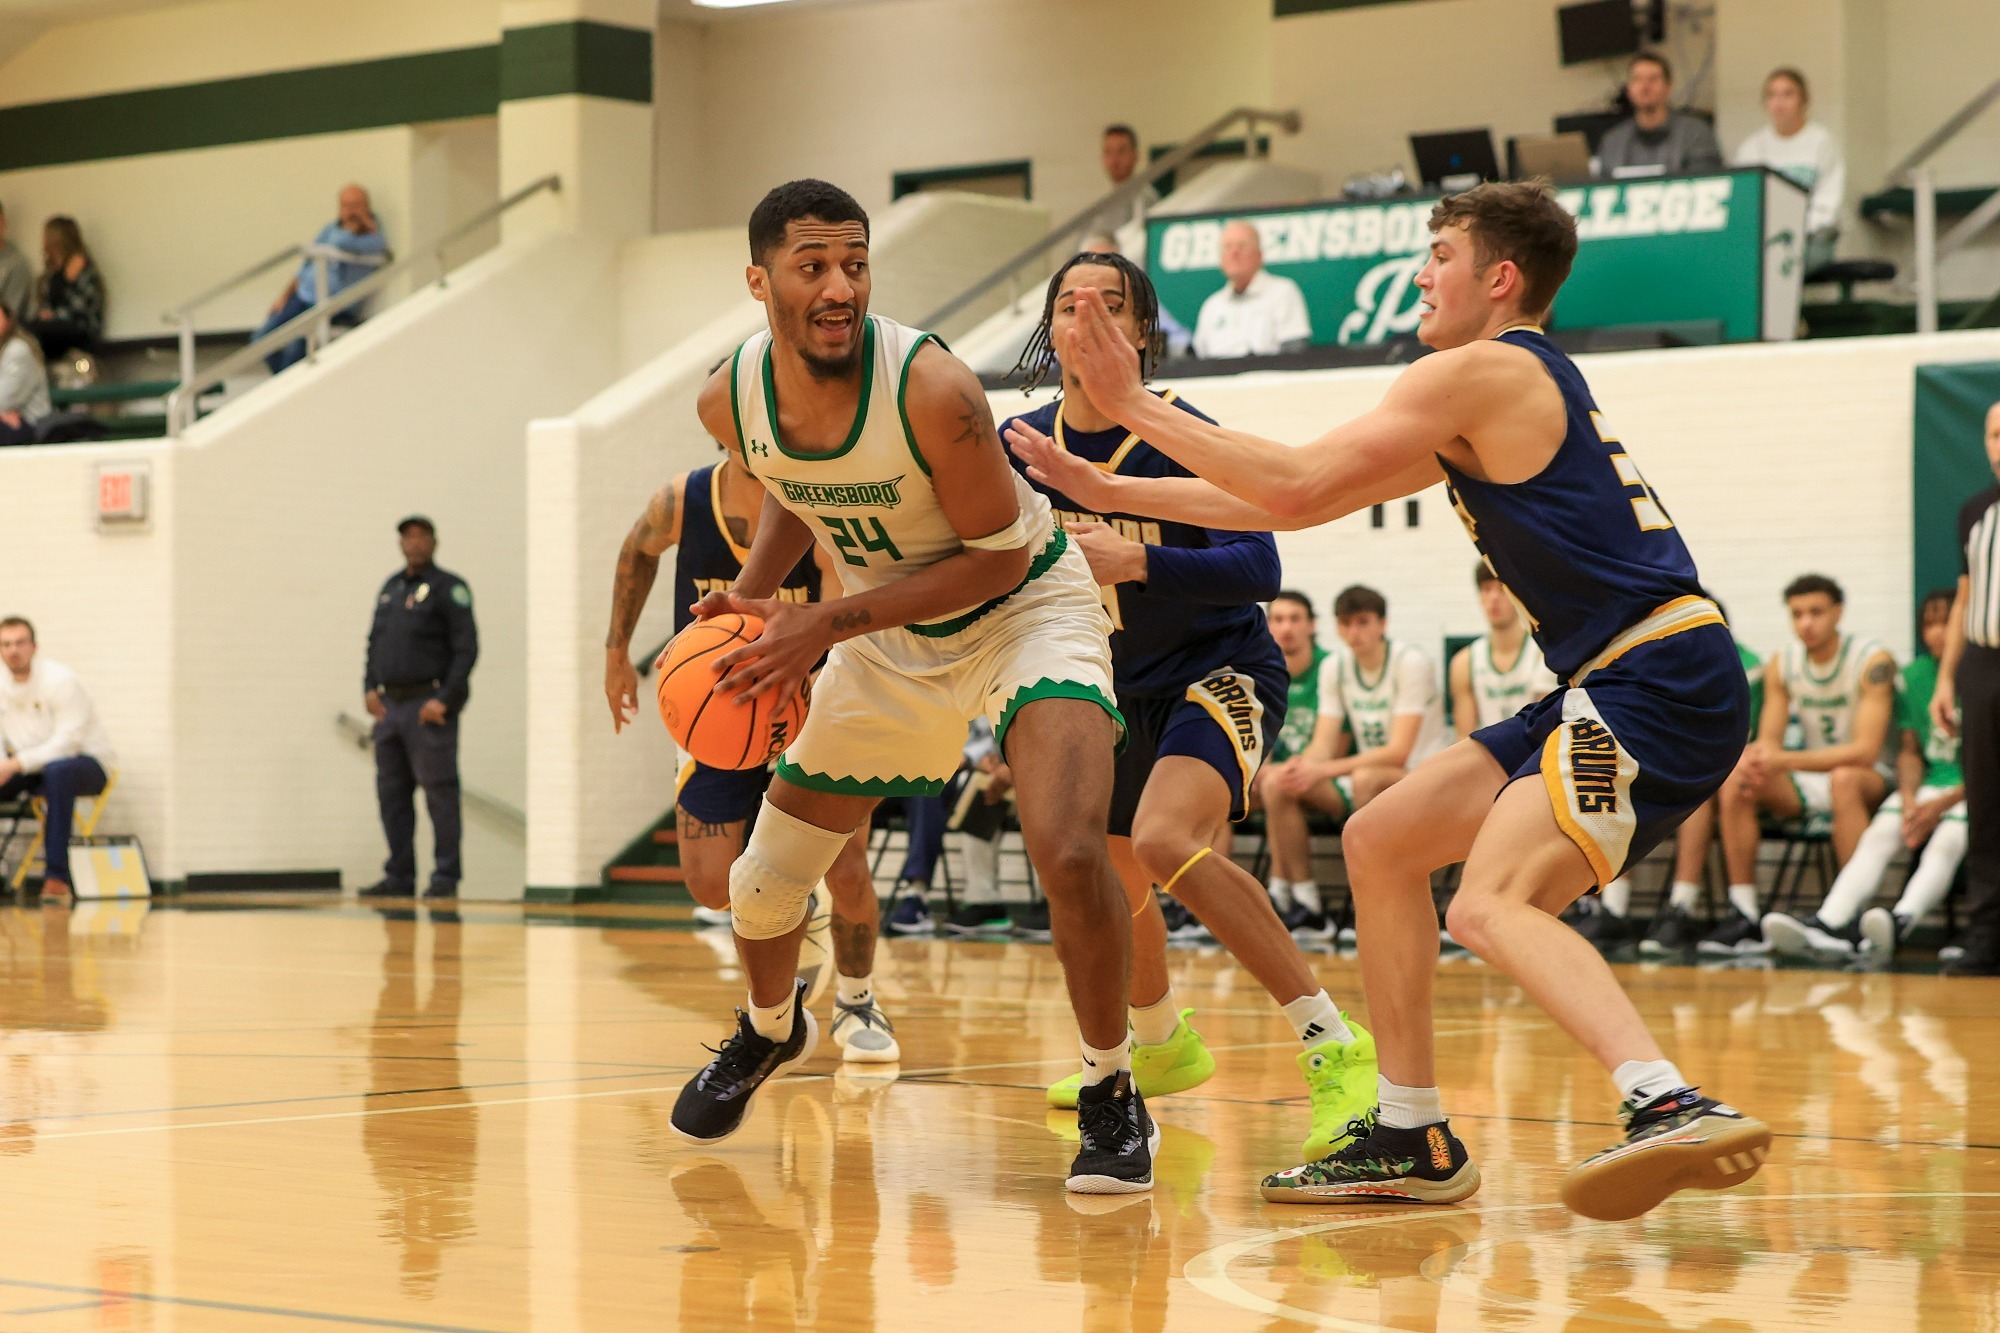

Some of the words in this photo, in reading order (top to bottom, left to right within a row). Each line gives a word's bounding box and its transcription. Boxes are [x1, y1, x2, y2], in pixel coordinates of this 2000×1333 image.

[1159, 201, 1434, 271] GRENSBOR
[1556, 177, 1733, 241] LLEGE
[779, 480, 896, 505] GREENSBORO
[816, 515, 904, 567] 24
[764, 720, 789, 763] NCA
[1201, 674, 1256, 751] BRUINS
[1570, 718, 1618, 814] BRUINS
